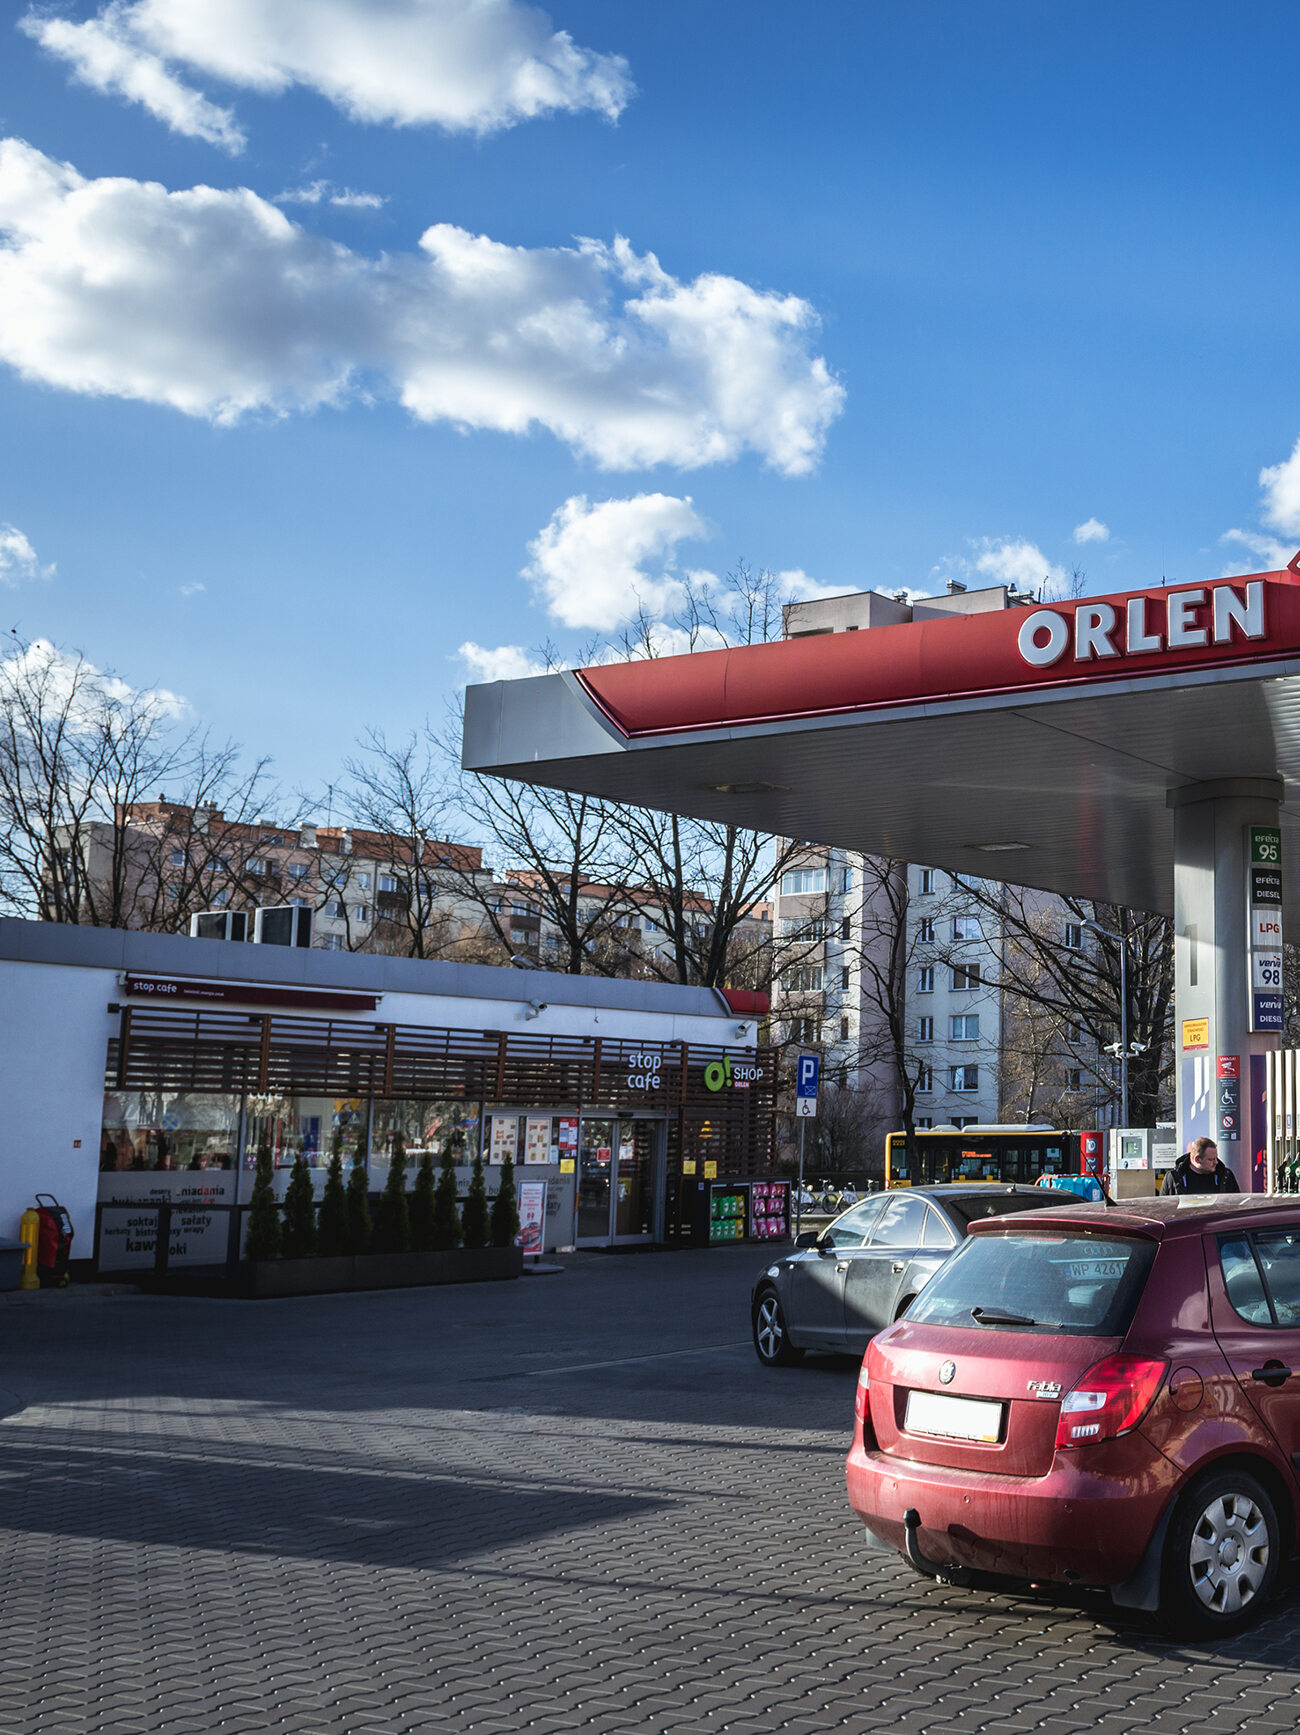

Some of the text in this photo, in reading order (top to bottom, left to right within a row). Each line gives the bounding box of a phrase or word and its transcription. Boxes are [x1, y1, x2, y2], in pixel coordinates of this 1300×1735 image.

[1017, 580, 1266, 667] ORLEN
[1258, 844, 1277, 861] 95
[1256, 890, 1280, 899] DIESEL
[1259, 923, 1280, 933] LPG
[1183, 923, 1198, 986] 1
[1262, 969, 1280, 985] 98
[133, 981, 154, 993] stop
[156, 983, 177, 993] cafe
[1189, 1033, 1201, 1042] LPG
[628, 1052, 662, 1073] stop
[733, 1067, 764, 1081] SHOP
[802, 1059, 815, 1085] P
[627, 1072, 661, 1091] cafe
[177, 1185, 225, 1196] niadania
[181, 1215, 212, 1227] sałaty
[169, 1242, 187, 1255] oki
[1071, 1263, 1089, 1276] WP
[1026, 1380, 1062, 1392] Fabia
